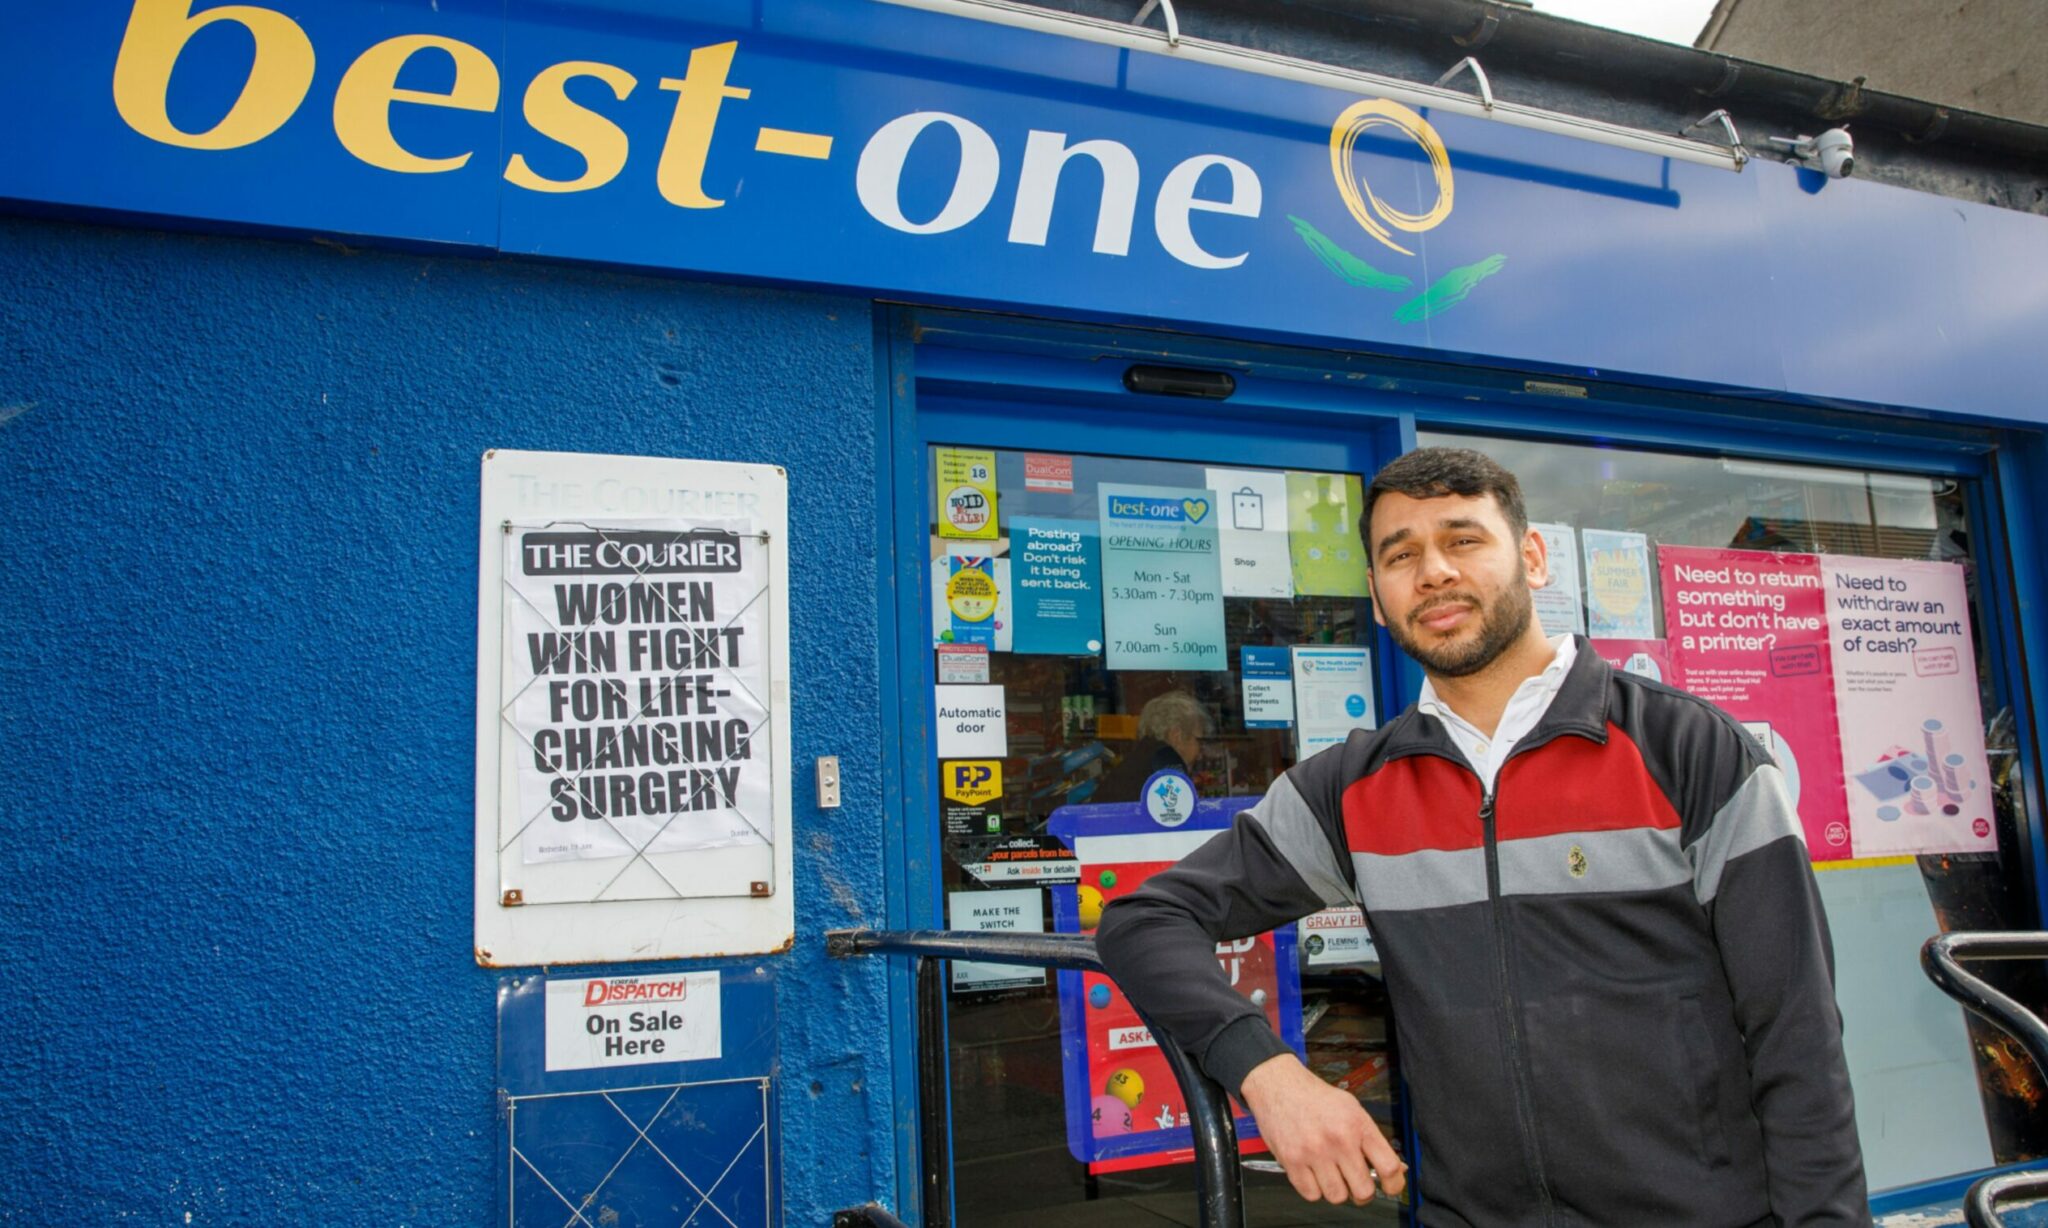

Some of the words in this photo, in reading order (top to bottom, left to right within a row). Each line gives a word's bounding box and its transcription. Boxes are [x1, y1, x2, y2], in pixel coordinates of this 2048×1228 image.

[113, 0, 1263, 270] best-one
[972, 468, 987, 479] 18
[1025, 463, 1073, 476] DualCom
[963, 494, 985, 509] ID
[1112, 498, 1181, 518] best-one
[1028, 527, 1081, 542] Posting
[1027, 541, 1083, 553] abroad?
[1108, 535, 1165, 549] OPENING
[1169, 537, 1213, 551] HOURS
[525, 544, 590, 569] THE
[595, 540, 739, 569] COURIER
[1023, 552, 1060, 563] Don't
[1062, 554, 1087, 565] risk
[1234, 557, 1257, 568] Shop
[1030, 565, 1040, 576] it
[1042, 566, 1081, 579] being
[1133, 570, 1162, 583] Mon
[1172, 570, 1191, 584] Sat
[1673, 564, 1731, 585] Need
[1733, 569, 1756, 586] to
[1759, 572, 1819, 589] return
[1021, 580, 1053, 588] sent
[1054, 579, 1092, 590] back.
[1607, 577, 1629, 588] FAIR
[1835, 573, 1884, 591] Need
[1888, 578, 1907, 592] to
[1111, 586, 1158, 600] 5.30am
[1169, 588, 1215, 605] 7.30pm
[1676, 589, 1786, 612] something
[554, 581, 715, 626] WOMEN
[1837, 595, 1919, 614] withdraw
[1923, 602, 1945, 614] an
[1679, 609, 1716, 629] but
[1718, 611, 1771, 630] don't
[1773, 613, 1820, 631] have
[1841, 617, 1891, 632] exact
[1895, 621, 1963, 635] amount
[1153, 622, 1177, 636] Sun
[1114, 640, 1161, 654] 7.00am
[1172, 641, 1218, 657] 5.00pm
[1681, 635, 1696, 649] a
[1699, 632, 1777, 654] printer?
[1843, 636, 1862, 652] of
[1866, 637, 1918, 653] cash?
[527, 631, 617, 676] WIN
[628, 627, 744, 673] FIGHT
[549, 679, 629, 723] FOR
[638, 674, 732, 718] LIFE-
[938, 707, 1002, 719] Automatic
[956, 722, 985, 733] door
[532, 718, 752, 775] CHANGING
[550, 766, 742, 823] SURGERY
[955, 789, 992, 798] PayPoint
[1010, 849, 1038, 860] parcels
[1039, 848, 1058, 857] from
[1007, 866, 1020, 876] Ask
[1021, 865, 1041, 875] inside
[1042, 865, 1052, 874] for
[1053, 863, 1076, 874] details
[972, 908, 1000, 917] MAKE
[1003, 907, 1021, 916] THE
[979, 920, 1015, 930] SWITCH
[1306, 915, 1347, 928] GRAVY
[1327, 937, 1360, 946] FLEMING
[585, 980, 684, 1007] DISPATCH
[586, 1014, 620, 1036] On
[629, 1010, 683, 1032] Sale
[1119, 1030, 1144, 1045] ASK
[605, 1036, 666, 1057] Here
